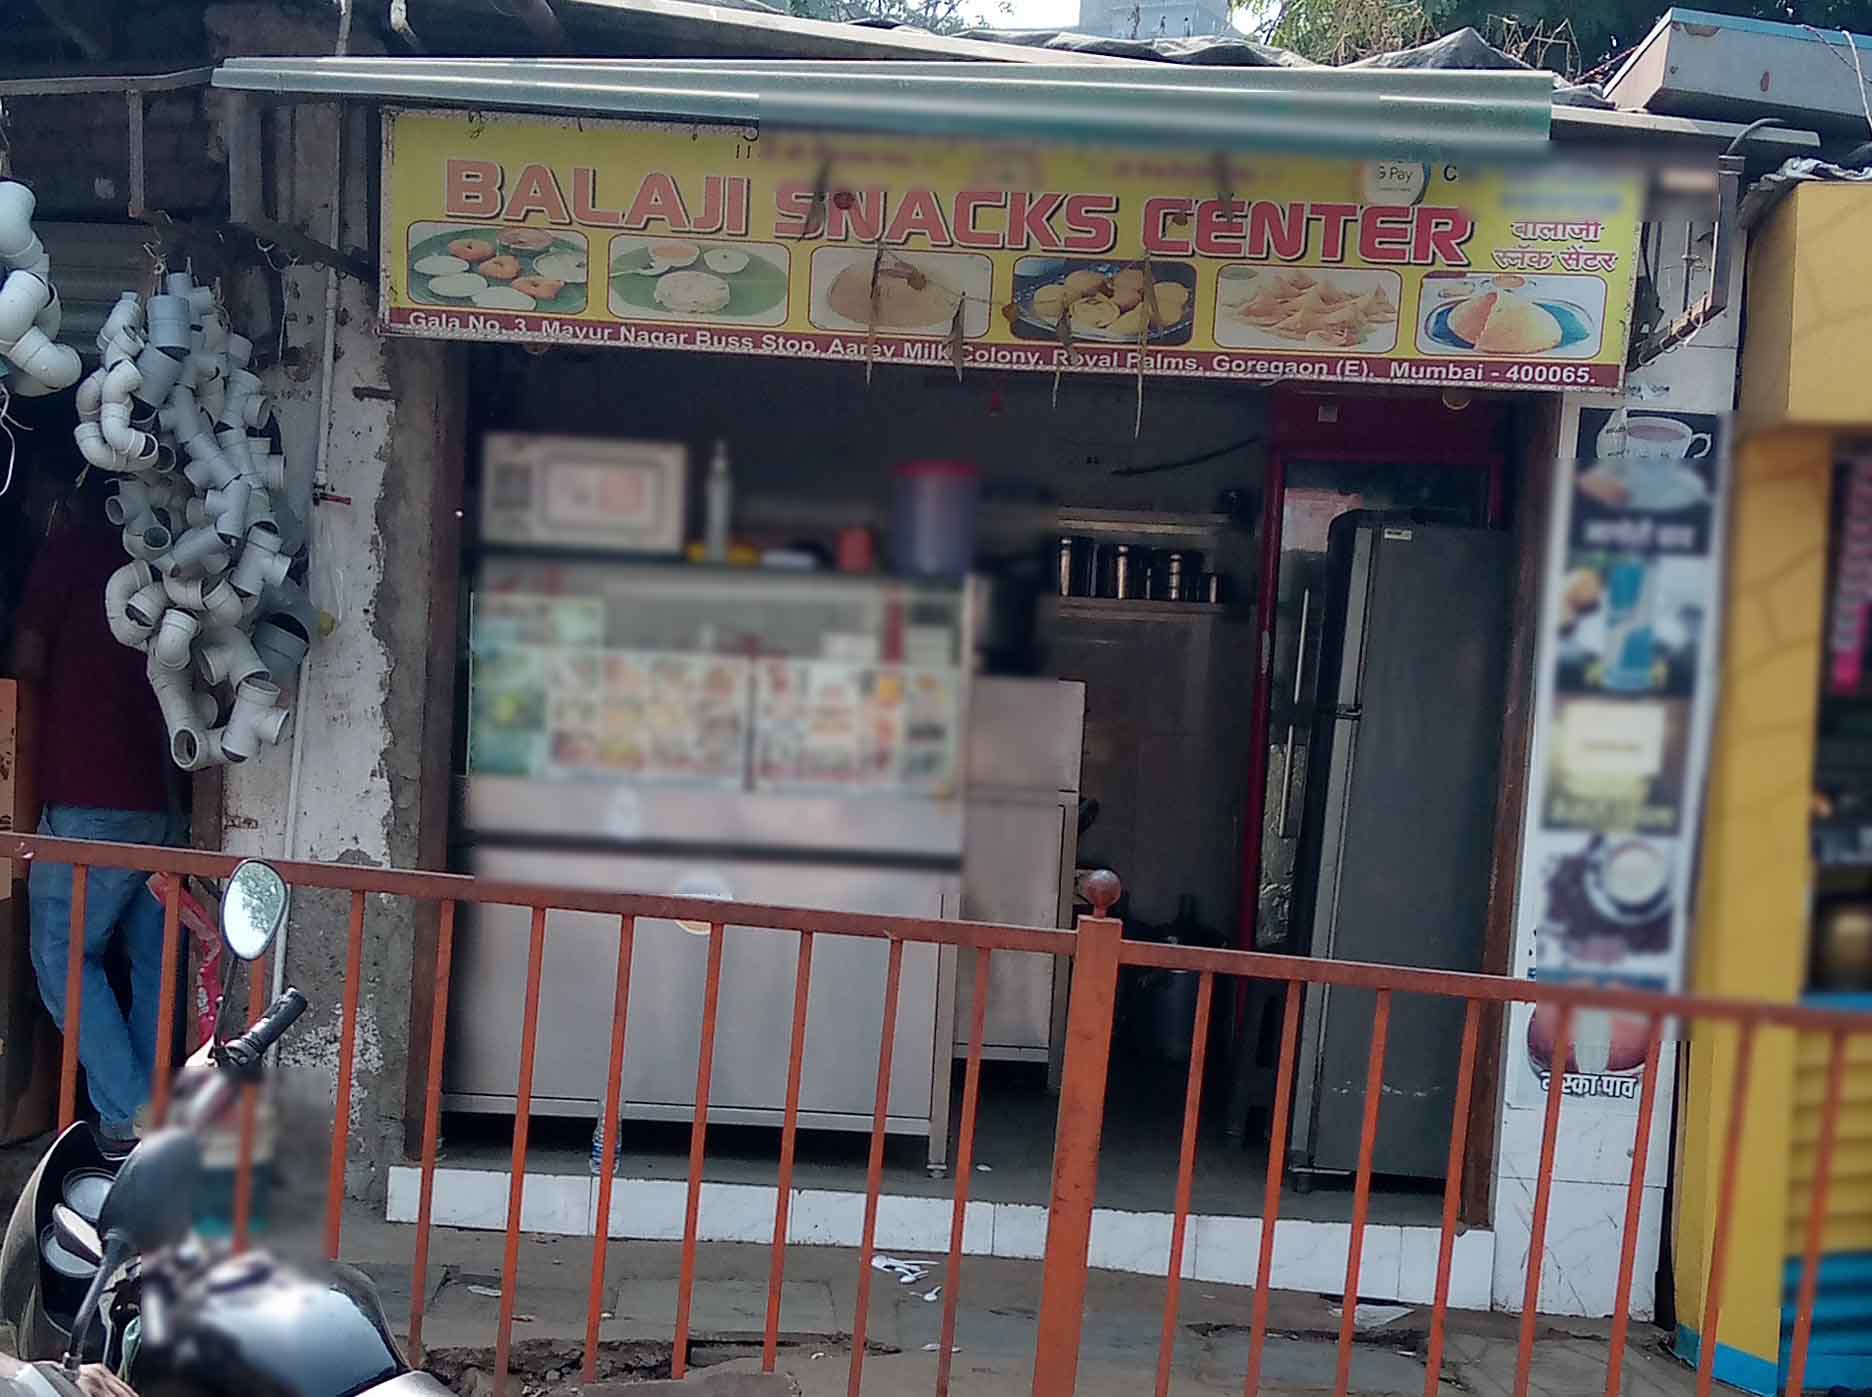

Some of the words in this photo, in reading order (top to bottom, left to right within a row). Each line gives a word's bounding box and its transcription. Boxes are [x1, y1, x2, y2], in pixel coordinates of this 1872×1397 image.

[1389, 166, 1414, 184] Pay
[445, 159, 750, 236] BALAJI
[774, 183, 1118, 253] SNACKS
[1142, 198, 1474, 266] CENTER
[1556, 244, 1618, 272] सेंटर
[409, 311, 461, 331] Gala
[541, 319, 615, 342] Mayur
[619, 325, 690, 347] Nagar
[696, 330, 754, 350] Buss
[828, 338, 896, 359] Aarey
[902, 341, 953, 361] Milk
[1212, 355, 1328, 378] Goregaon
[1390, 361, 1484, 380] Mumbai
[1505, 365, 1596, 383] 400065.
[1599, 1074, 1639, 1099] पाव
